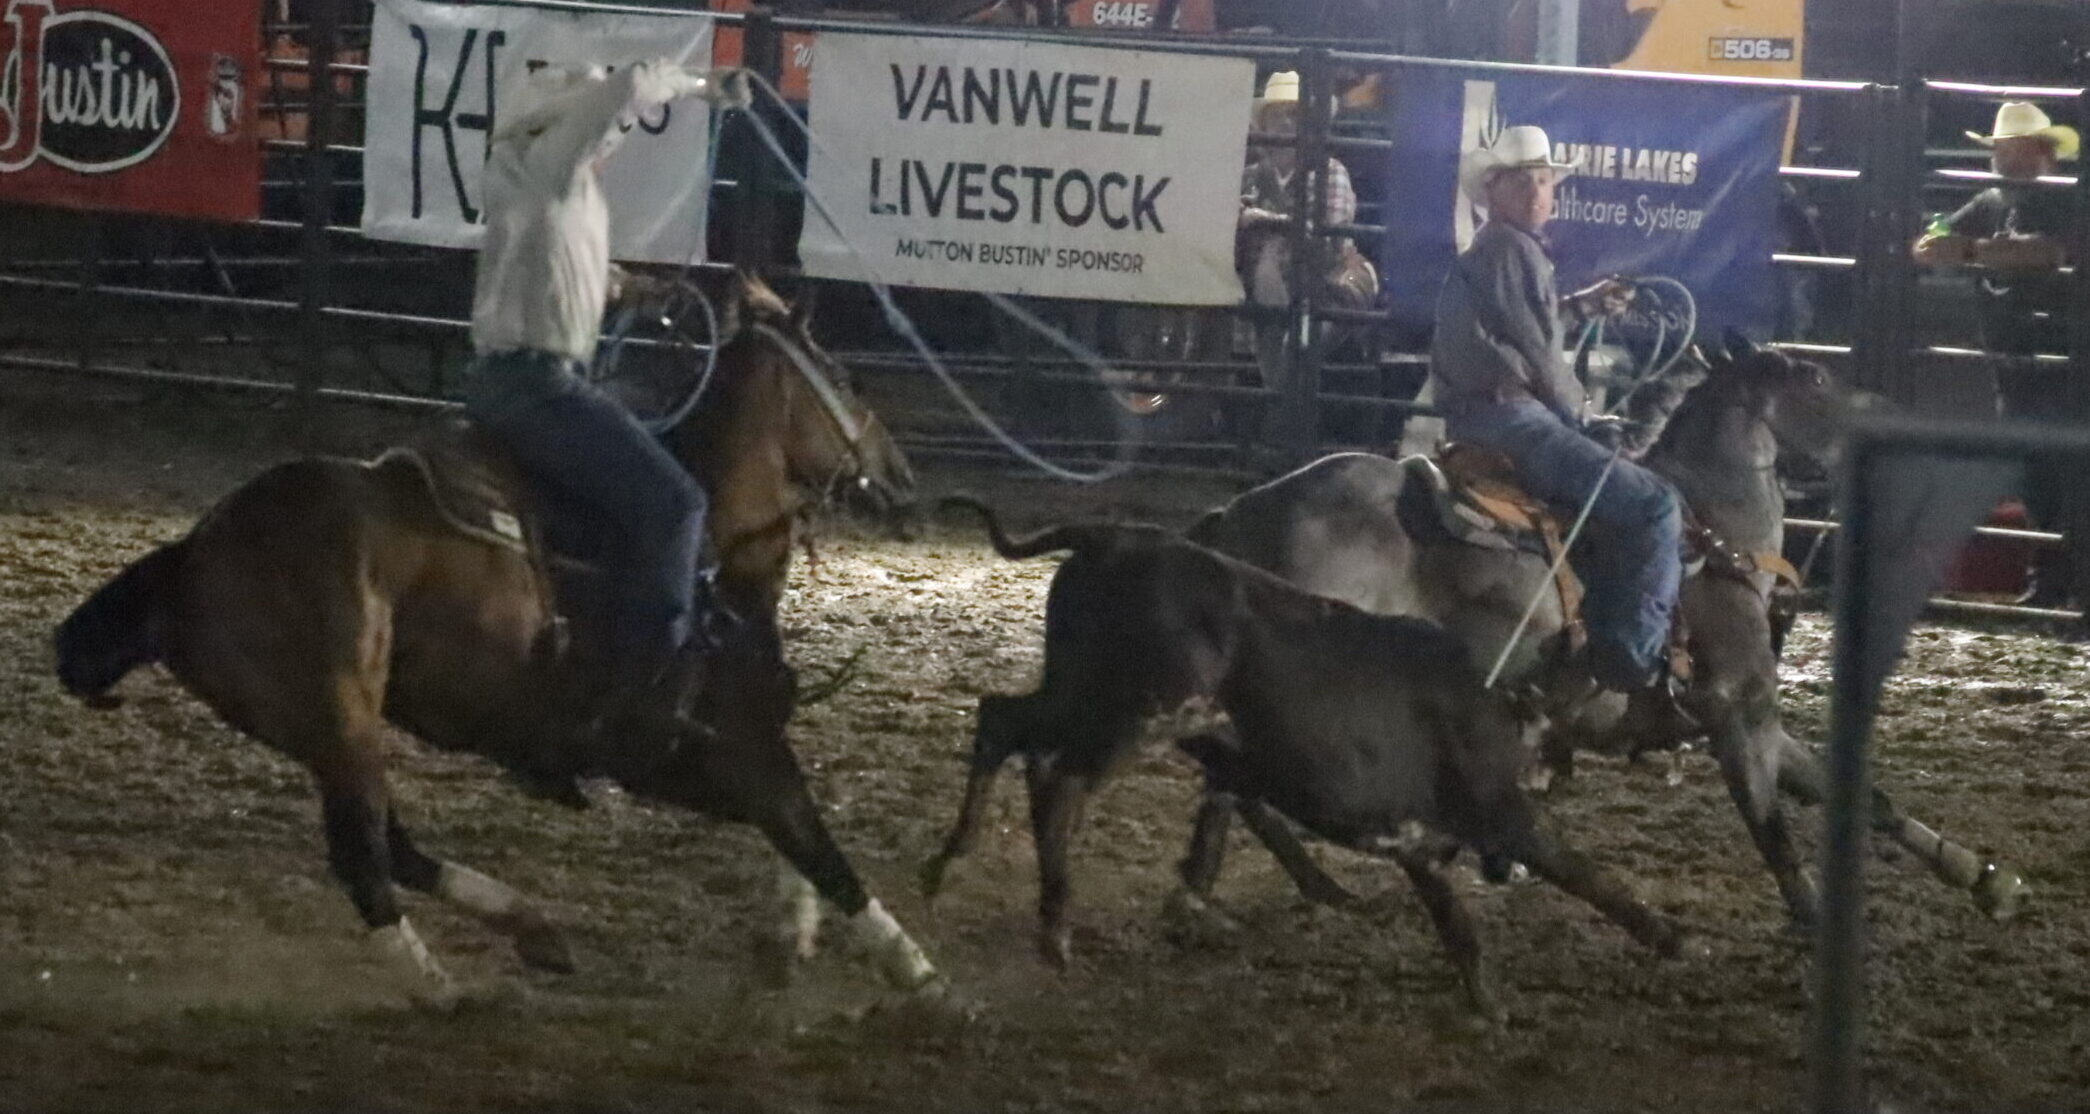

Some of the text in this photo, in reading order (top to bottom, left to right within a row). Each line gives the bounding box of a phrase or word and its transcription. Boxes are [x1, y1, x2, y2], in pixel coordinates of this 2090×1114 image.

[0, 0, 161, 173] Justin
[889, 62, 1163, 137] VANWELL
[1553, 142, 1698, 185] AIRIE LAKES
[868, 157, 1172, 234] LIVESTOCK
[1549, 186, 1704, 237] althcare System
[896, 238, 1144, 274] MUTTON BUSTIN' SPONSOR
